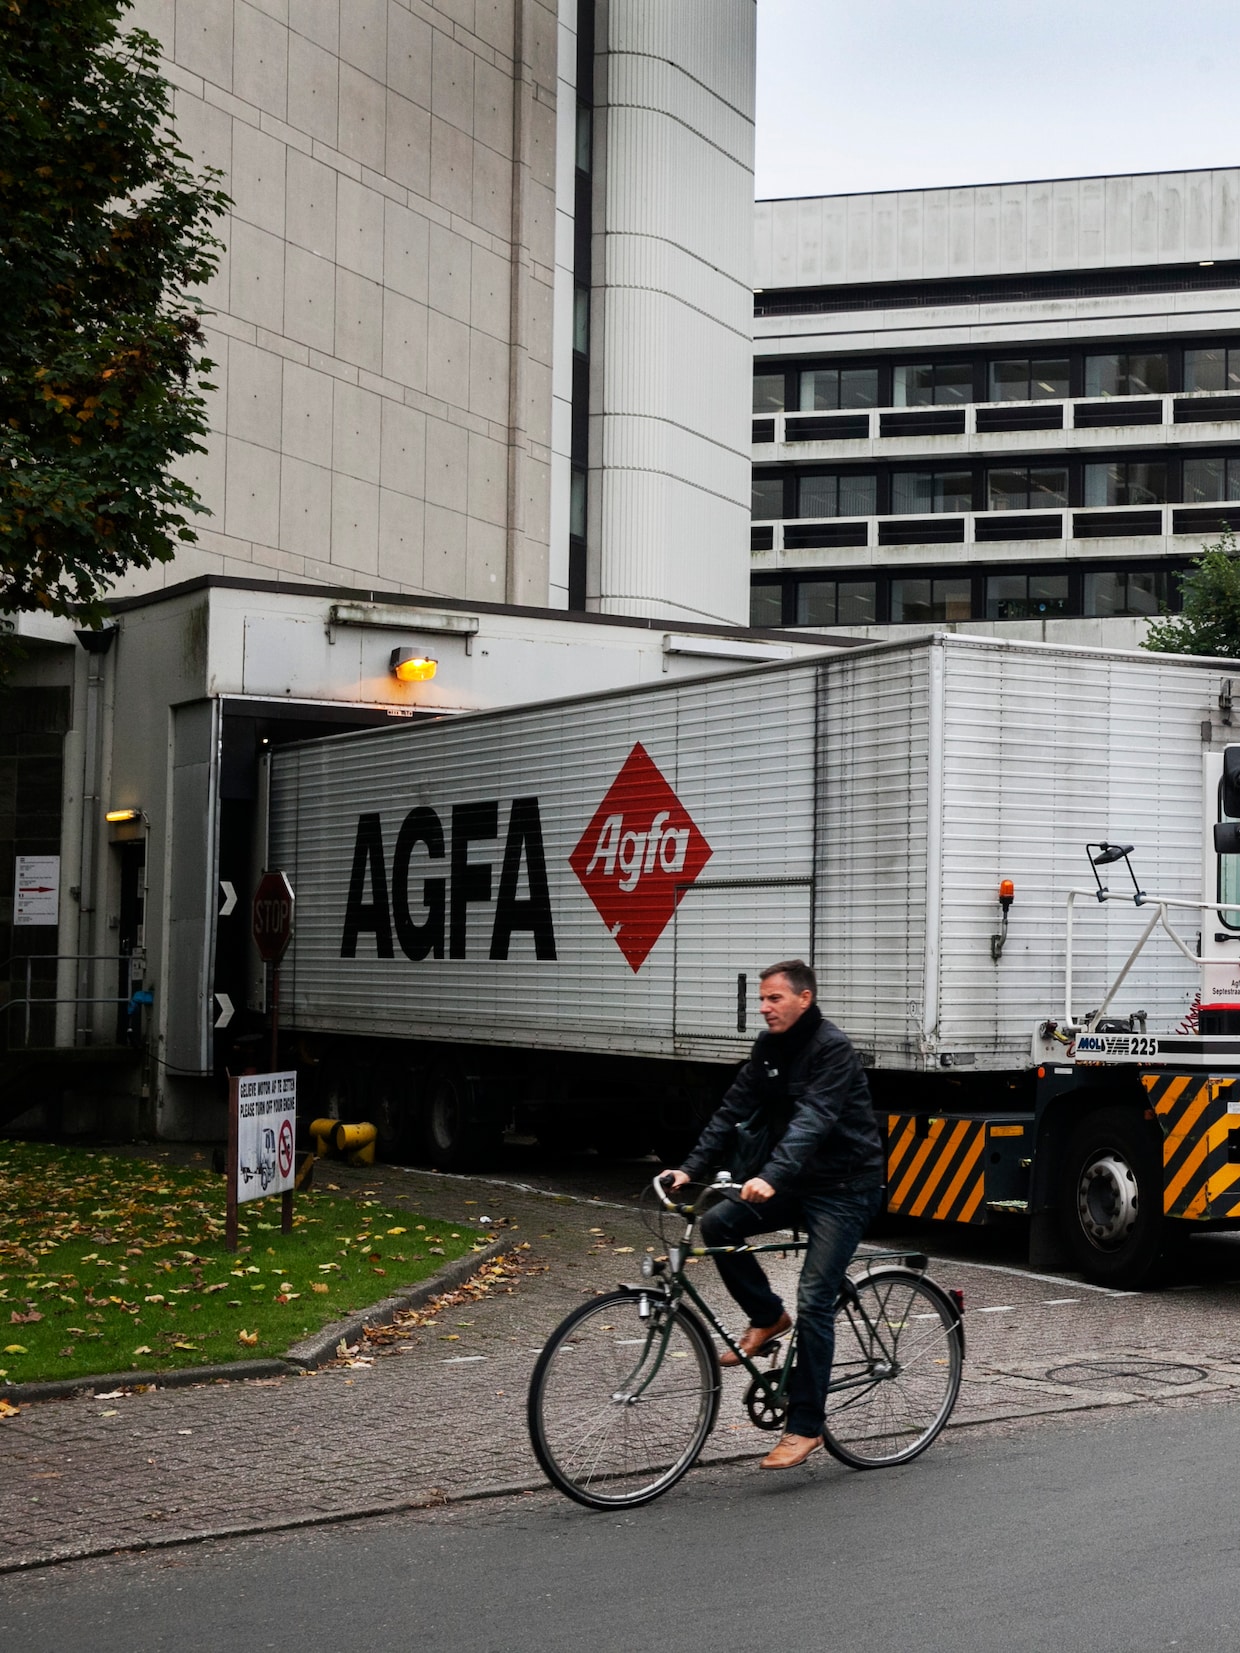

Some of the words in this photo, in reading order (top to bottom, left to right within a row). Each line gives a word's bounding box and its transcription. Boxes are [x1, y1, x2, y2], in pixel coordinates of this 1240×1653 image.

[586, 810, 690, 893] Agfa
[340, 796, 557, 962] AGFA
[255, 900, 289, 934] STOP
[1077, 1037, 1101, 1050] MOL
[1130, 1037, 1156, 1056] 225
[240, 1082, 257, 1098] GELIEVE
[257, 1081, 271, 1096] MOTOR
[240, 1102, 255, 1118] PLEASE
[255, 1101, 266, 1116] TURN
[273, 1098, 283, 1113] YOUR
[283, 1096, 295, 1111] ENGINE
